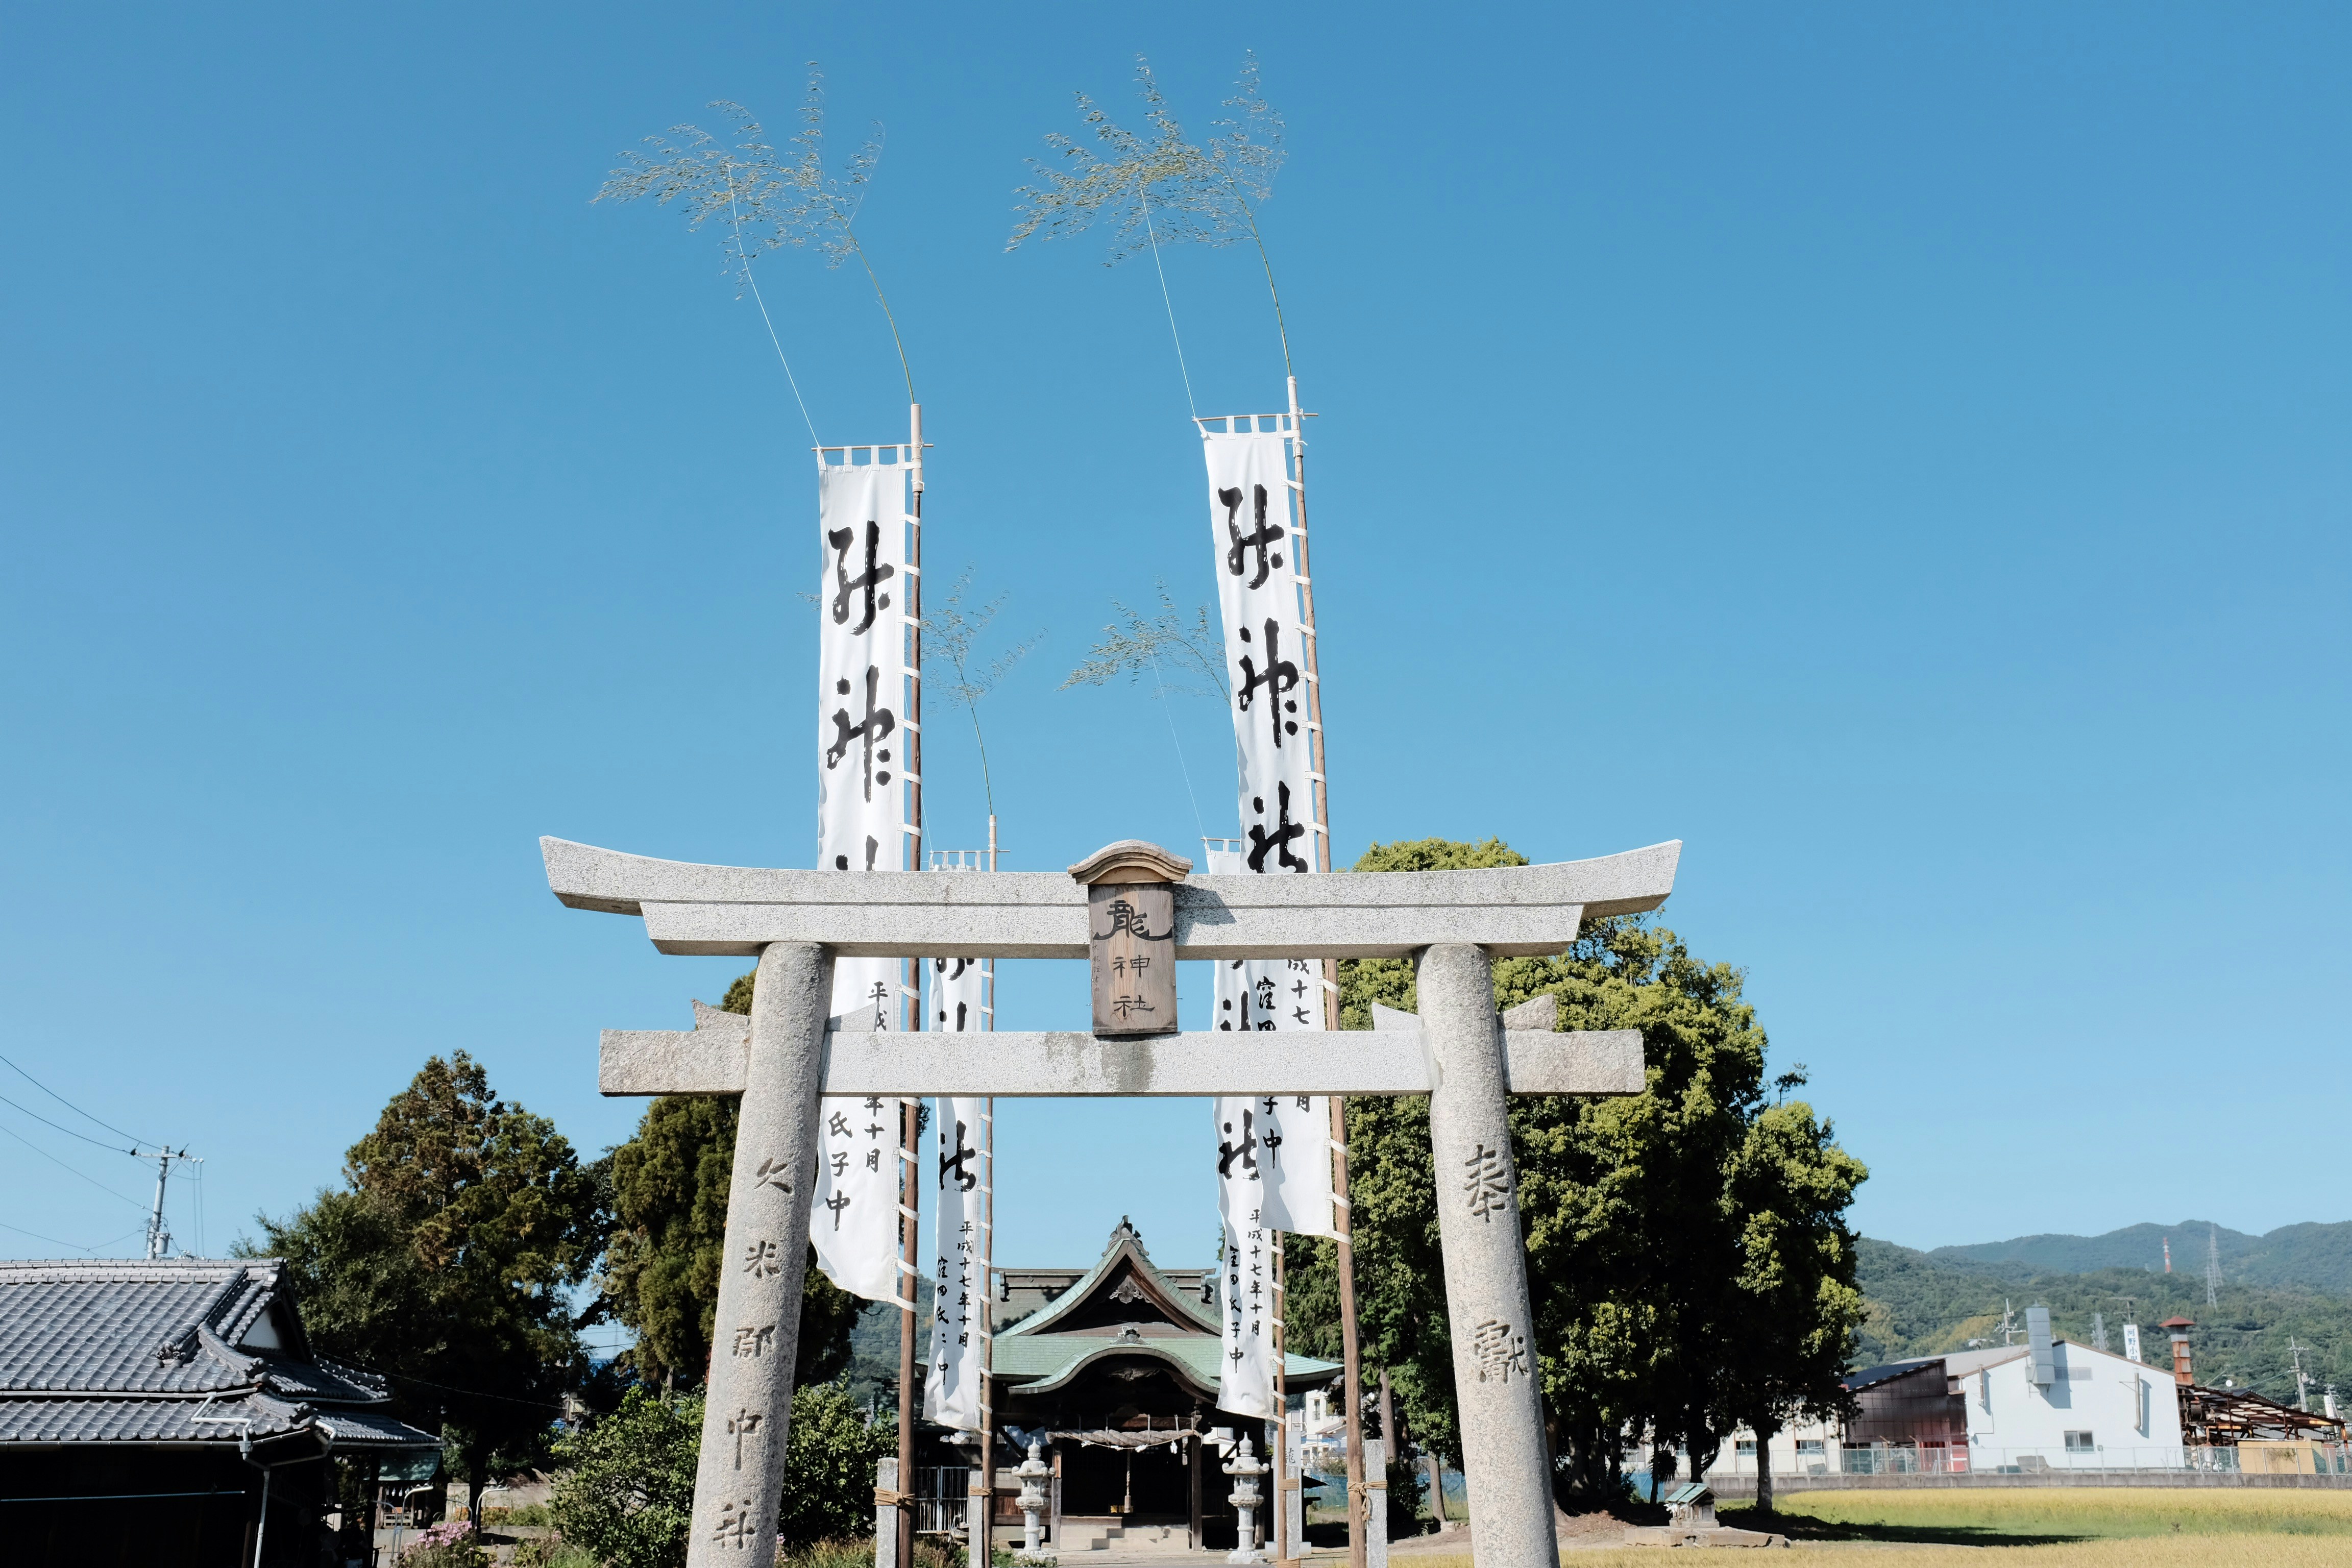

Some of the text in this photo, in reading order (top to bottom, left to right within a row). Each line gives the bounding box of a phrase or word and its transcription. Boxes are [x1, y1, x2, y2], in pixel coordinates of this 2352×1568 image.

[1093, 900, 1173, 1017] 龍神社
[957, 1221, 974, 1348] 平成十七年十月
[1248, 1209, 1263, 1336] 平成十七年十月
